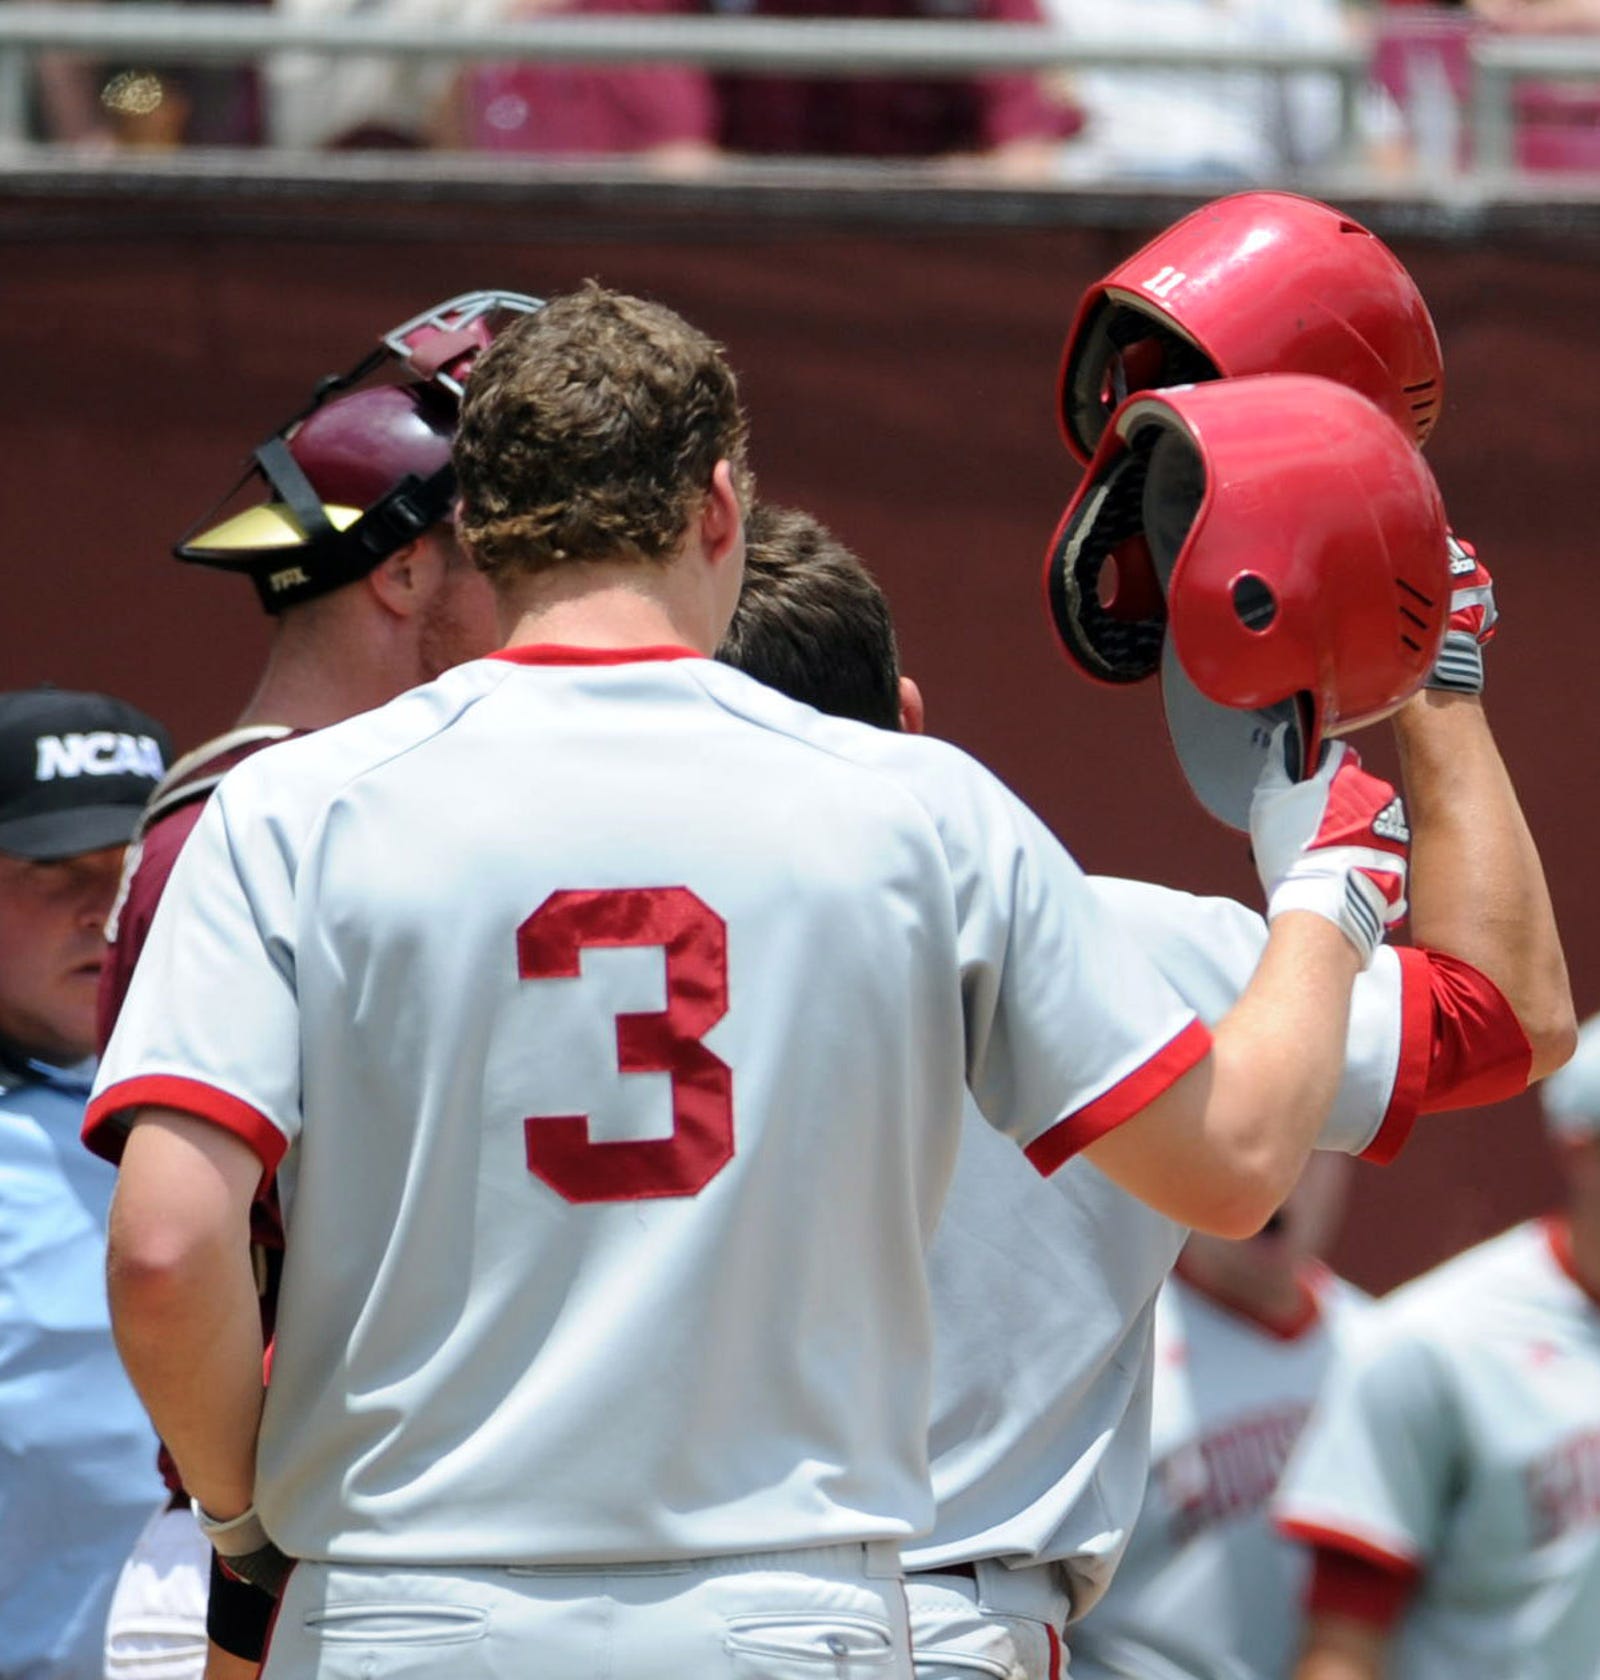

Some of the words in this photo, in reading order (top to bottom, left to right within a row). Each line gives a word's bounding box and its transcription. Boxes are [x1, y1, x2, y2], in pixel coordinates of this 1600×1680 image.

[1142, 266, 1186, 298] 11
[36, 731, 166, 781] NCAA
[517, 886, 734, 1204] 3
